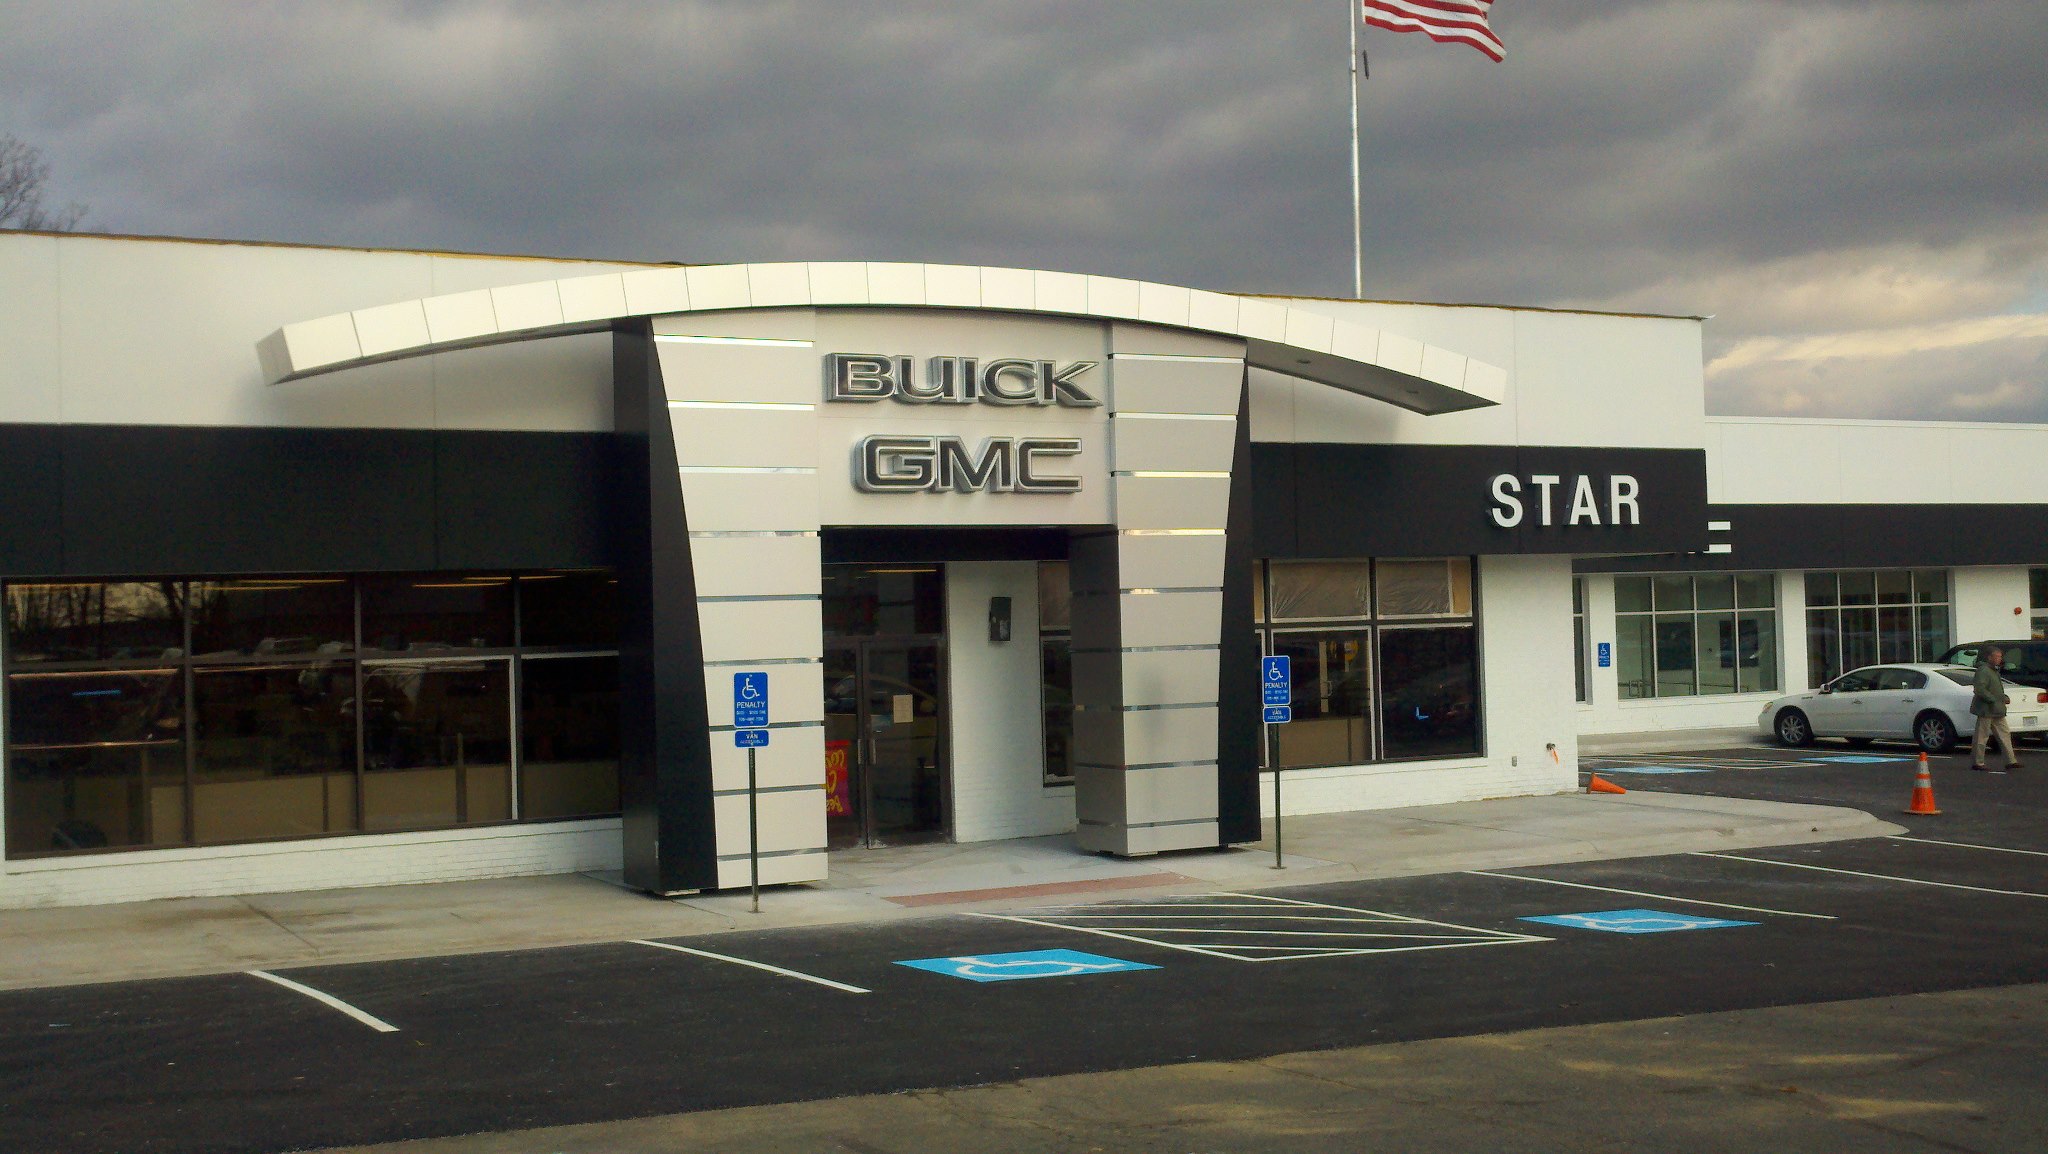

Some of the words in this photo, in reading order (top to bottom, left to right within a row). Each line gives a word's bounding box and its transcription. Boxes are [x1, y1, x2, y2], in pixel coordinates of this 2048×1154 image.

[825, 353, 1103, 407] BUICK
[852, 434, 1083, 492] GMC
[1490, 473, 1641, 528] STAR
[736, 701, 766, 709] PENALTY
